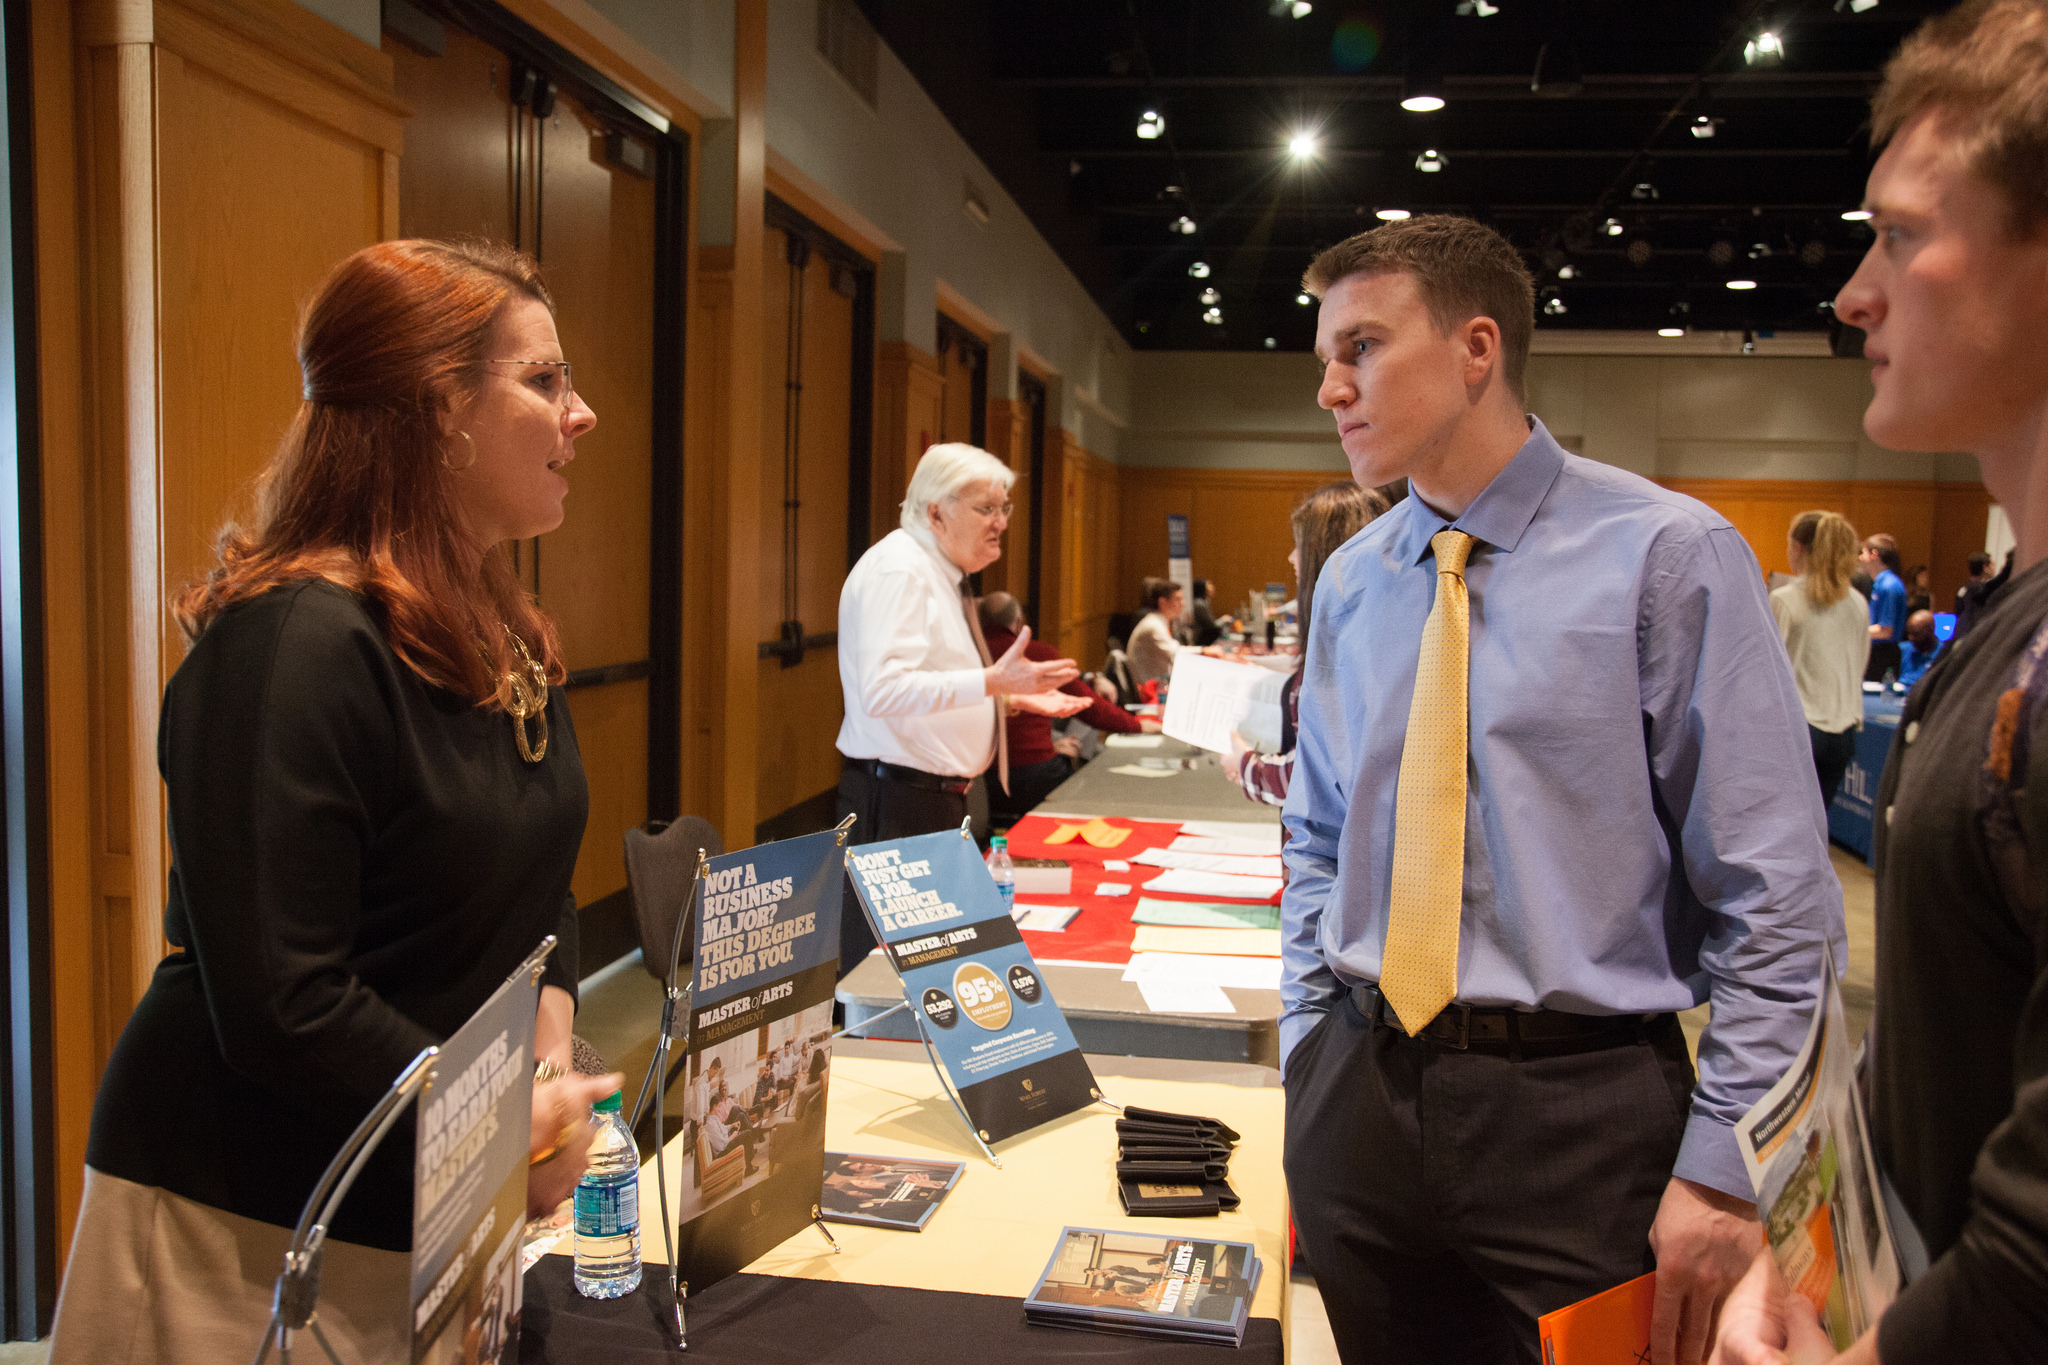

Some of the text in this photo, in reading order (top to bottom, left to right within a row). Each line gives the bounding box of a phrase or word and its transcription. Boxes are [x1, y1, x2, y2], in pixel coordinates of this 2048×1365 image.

[853, 849, 902, 871] DON'T
[861, 860, 931, 886] JUST GET
[704, 863, 758, 897] NOT A
[867, 879, 917, 901] A JOB.
[703, 876, 793, 921] BUSINESS
[873, 889, 942, 917] LAUNCH
[701, 903, 778, 944] MAJOR?
[882, 902, 964, 932] A CAREER.
[700, 912, 816, 968] THIS DEGREE
[895, 927, 977, 956] MASTER of ARTS
[907, 945, 959, 965] MANAGEMENT
[699, 940, 794, 992] IS FOR YOU.
[698, 981, 793, 1029] MASTER of ARTS
[957, 977, 1004, 1008] 95%
[971, 1001, 1007, 1017] EMPLOYMENT
[706, 1009, 766, 1041] MANAGEMENT
[444, 1029, 508, 1125] MONTHS
[422, 1131, 448, 1183] TO
[446, 1081, 491, 1158] EARN
[488, 1044, 524, 1109] YOUR
[1755, 1098, 1797, 1143] Northwestern
[1158, 1278, 1185, 1313] MASTER
[1172, 1245, 1194, 1273] ARTS
[1184, 1258, 1207, 1301] MANAGEMENT
